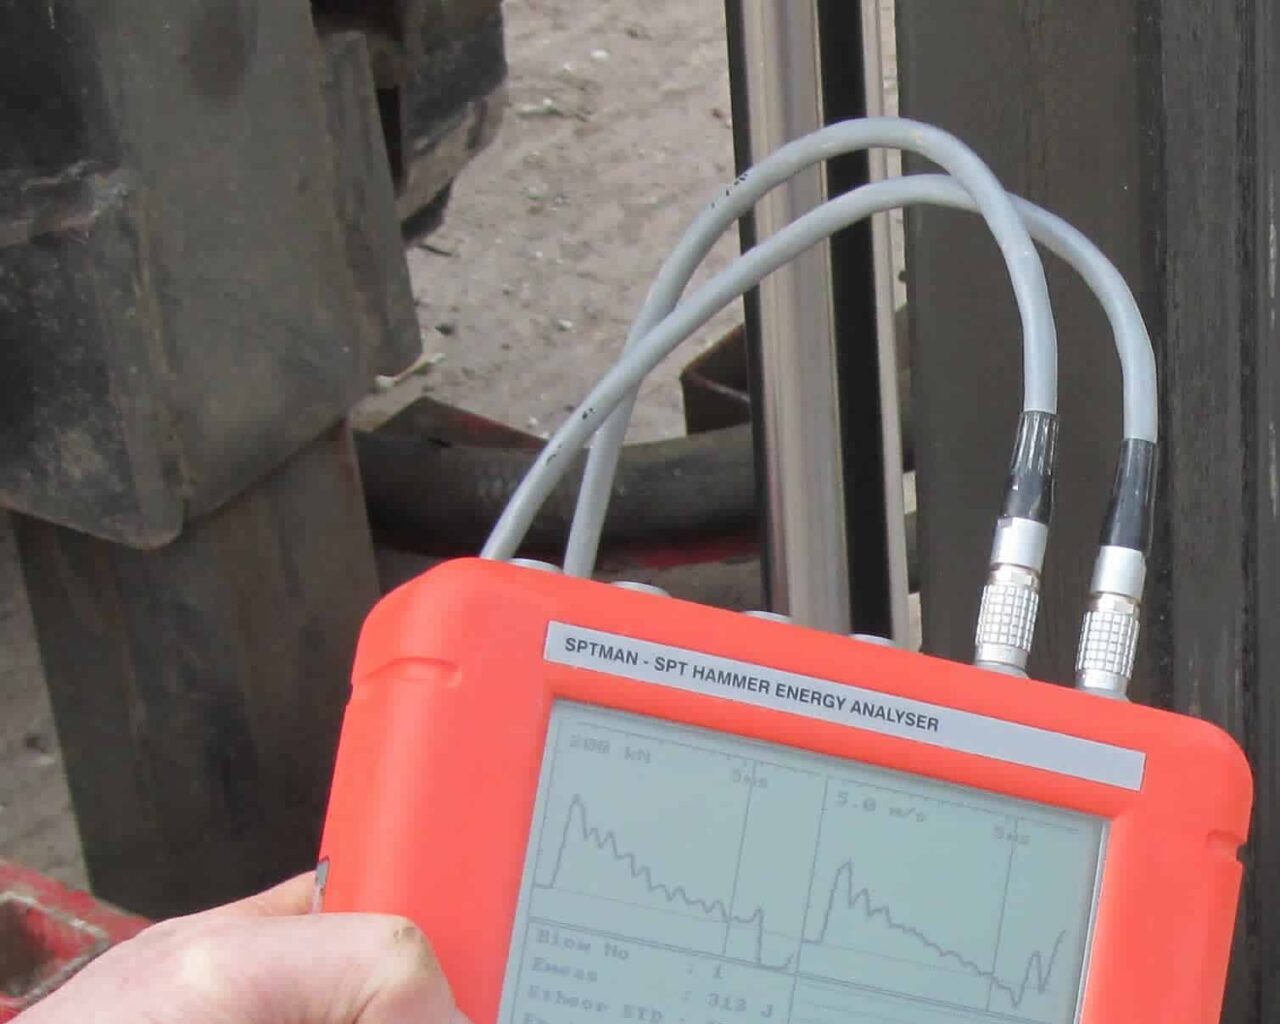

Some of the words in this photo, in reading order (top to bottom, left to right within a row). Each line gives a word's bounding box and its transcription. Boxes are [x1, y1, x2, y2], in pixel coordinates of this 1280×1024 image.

[564, 637, 639, 666] SPTMAN
[654, 657, 688, 676] SPT
[692, 665, 770, 694] HAMMER
[775, 683, 847, 711] ENERGY
[849, 700, 940, 732] ANALYSER
[536, 929, 591, 952] Blow
[604, 942, 630, 960] No
[760, 1004, 774, 1019] J
